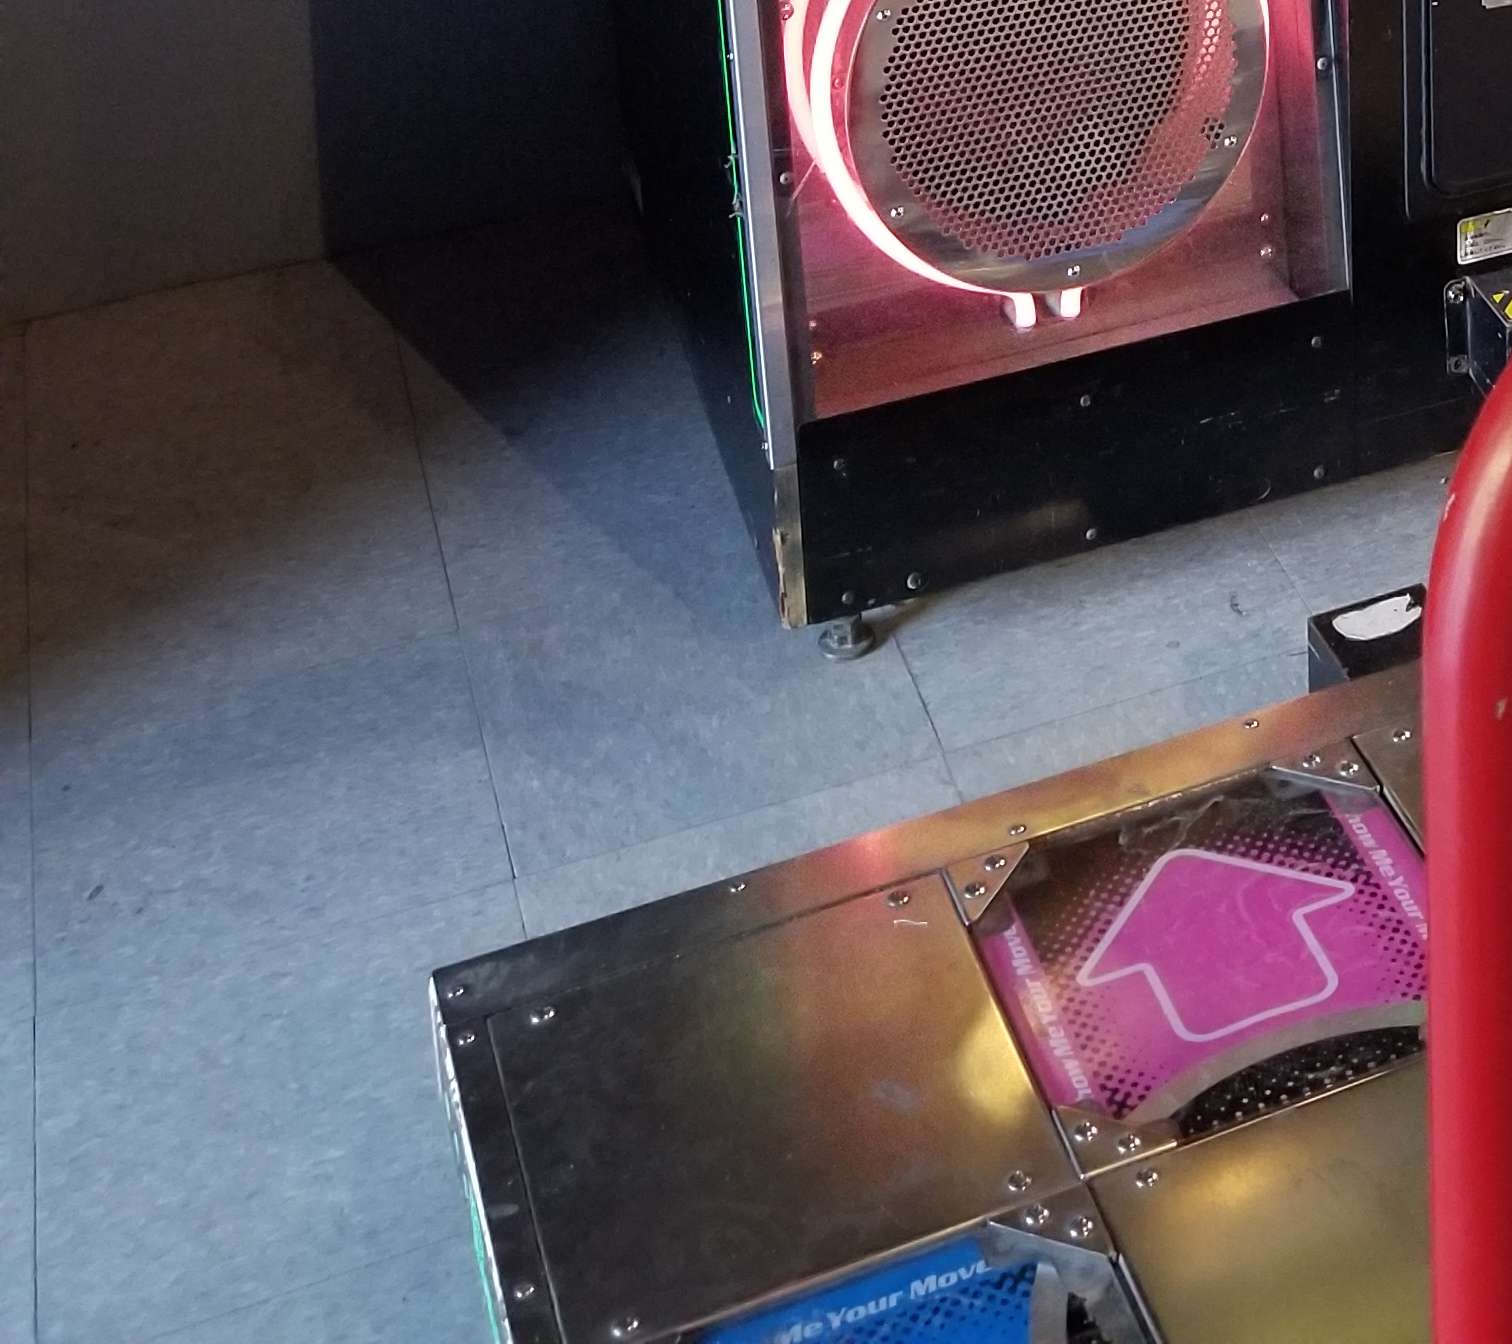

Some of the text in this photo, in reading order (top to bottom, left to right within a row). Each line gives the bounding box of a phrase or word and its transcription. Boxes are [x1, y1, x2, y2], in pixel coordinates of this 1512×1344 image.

[1345, 813, 1379, 849] how
[1064, 1057, 1093, 1101] how
[825, 1290, 905, 1331] Your
